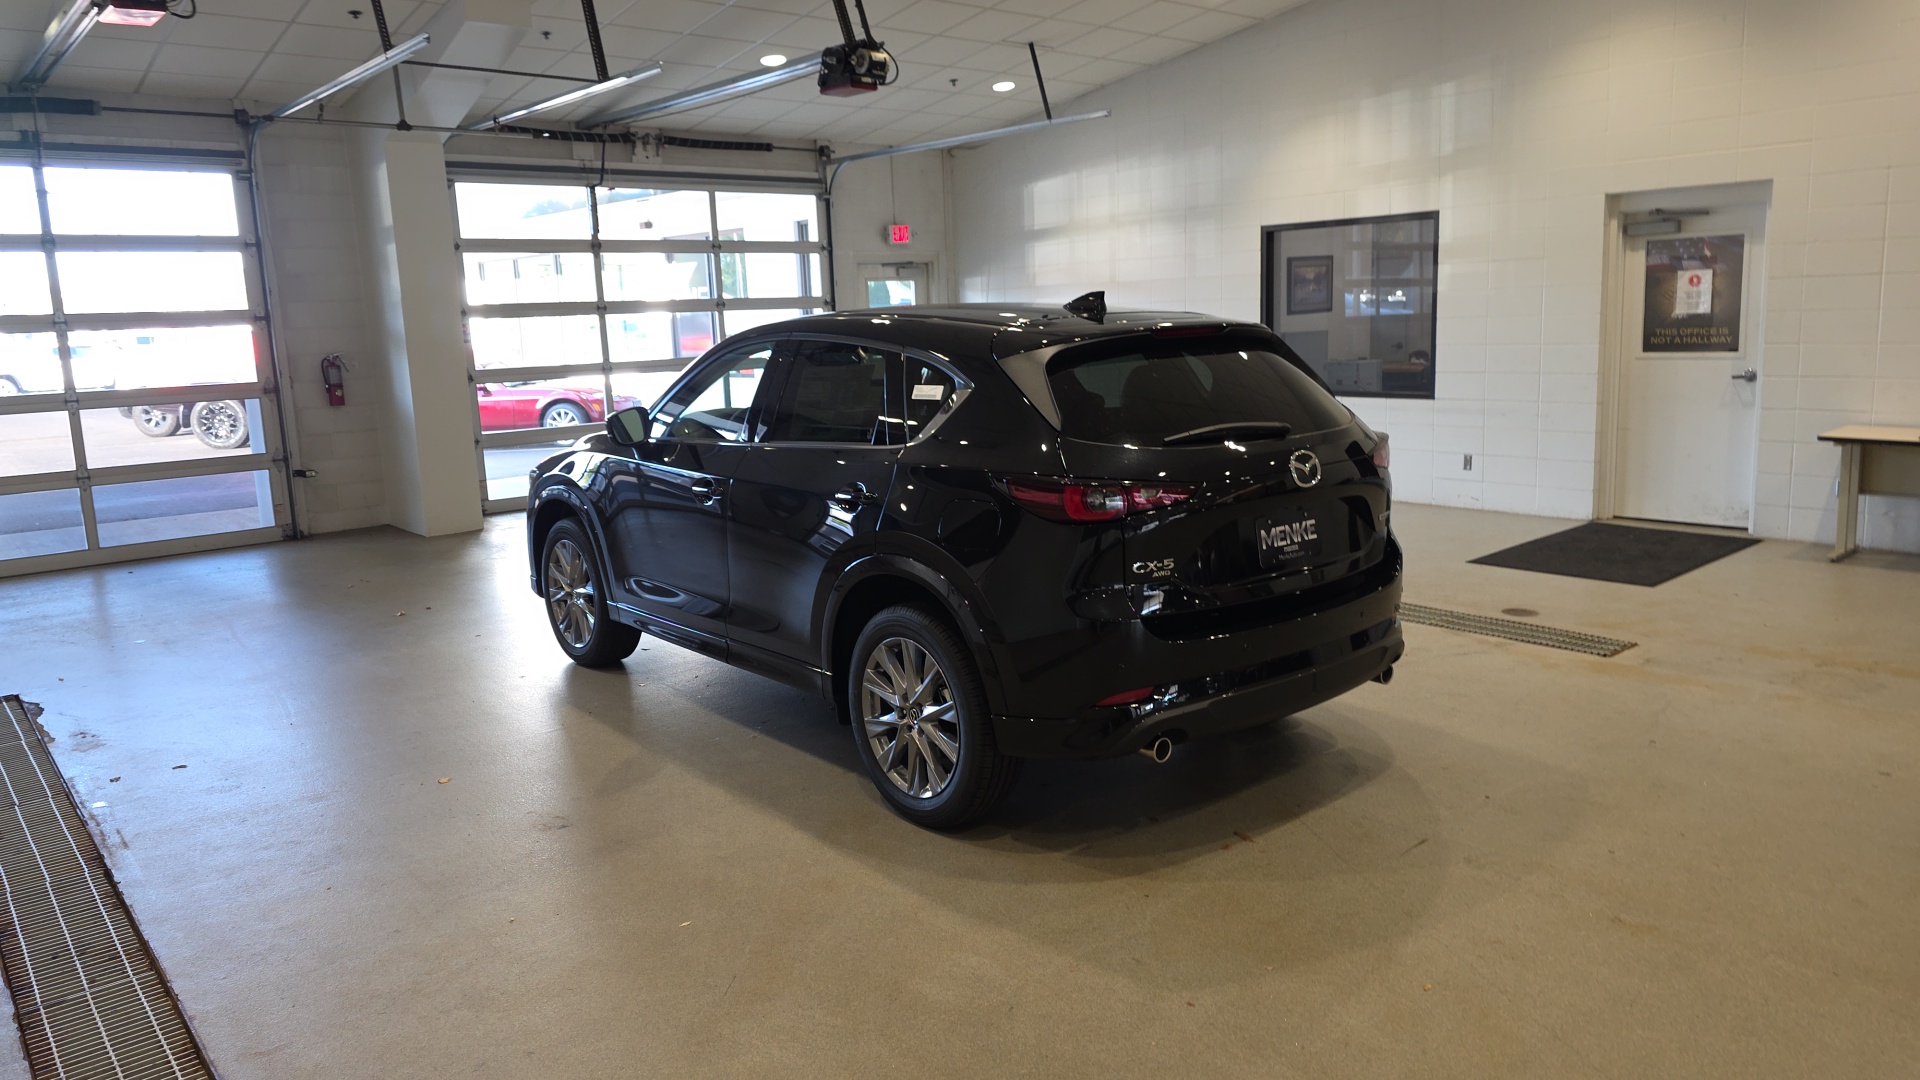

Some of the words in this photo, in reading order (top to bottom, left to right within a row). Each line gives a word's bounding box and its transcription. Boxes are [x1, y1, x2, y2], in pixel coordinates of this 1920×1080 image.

[1655, 328, 1677, 336] THIS
[1680, 327, 1717, 336] OFFICE
[1719, 327, 1729, 335] IS
[1650, 336, 1671, 344] NOT
[1674, 336, 1681, 344] A
[1683, 336, 1733, 344] HALLWAY
[1260, 518, 1318, 550] MENKE
[1132, 558, 1174, 574] CX-5
[1152, 570, 1171, 578] AWD
